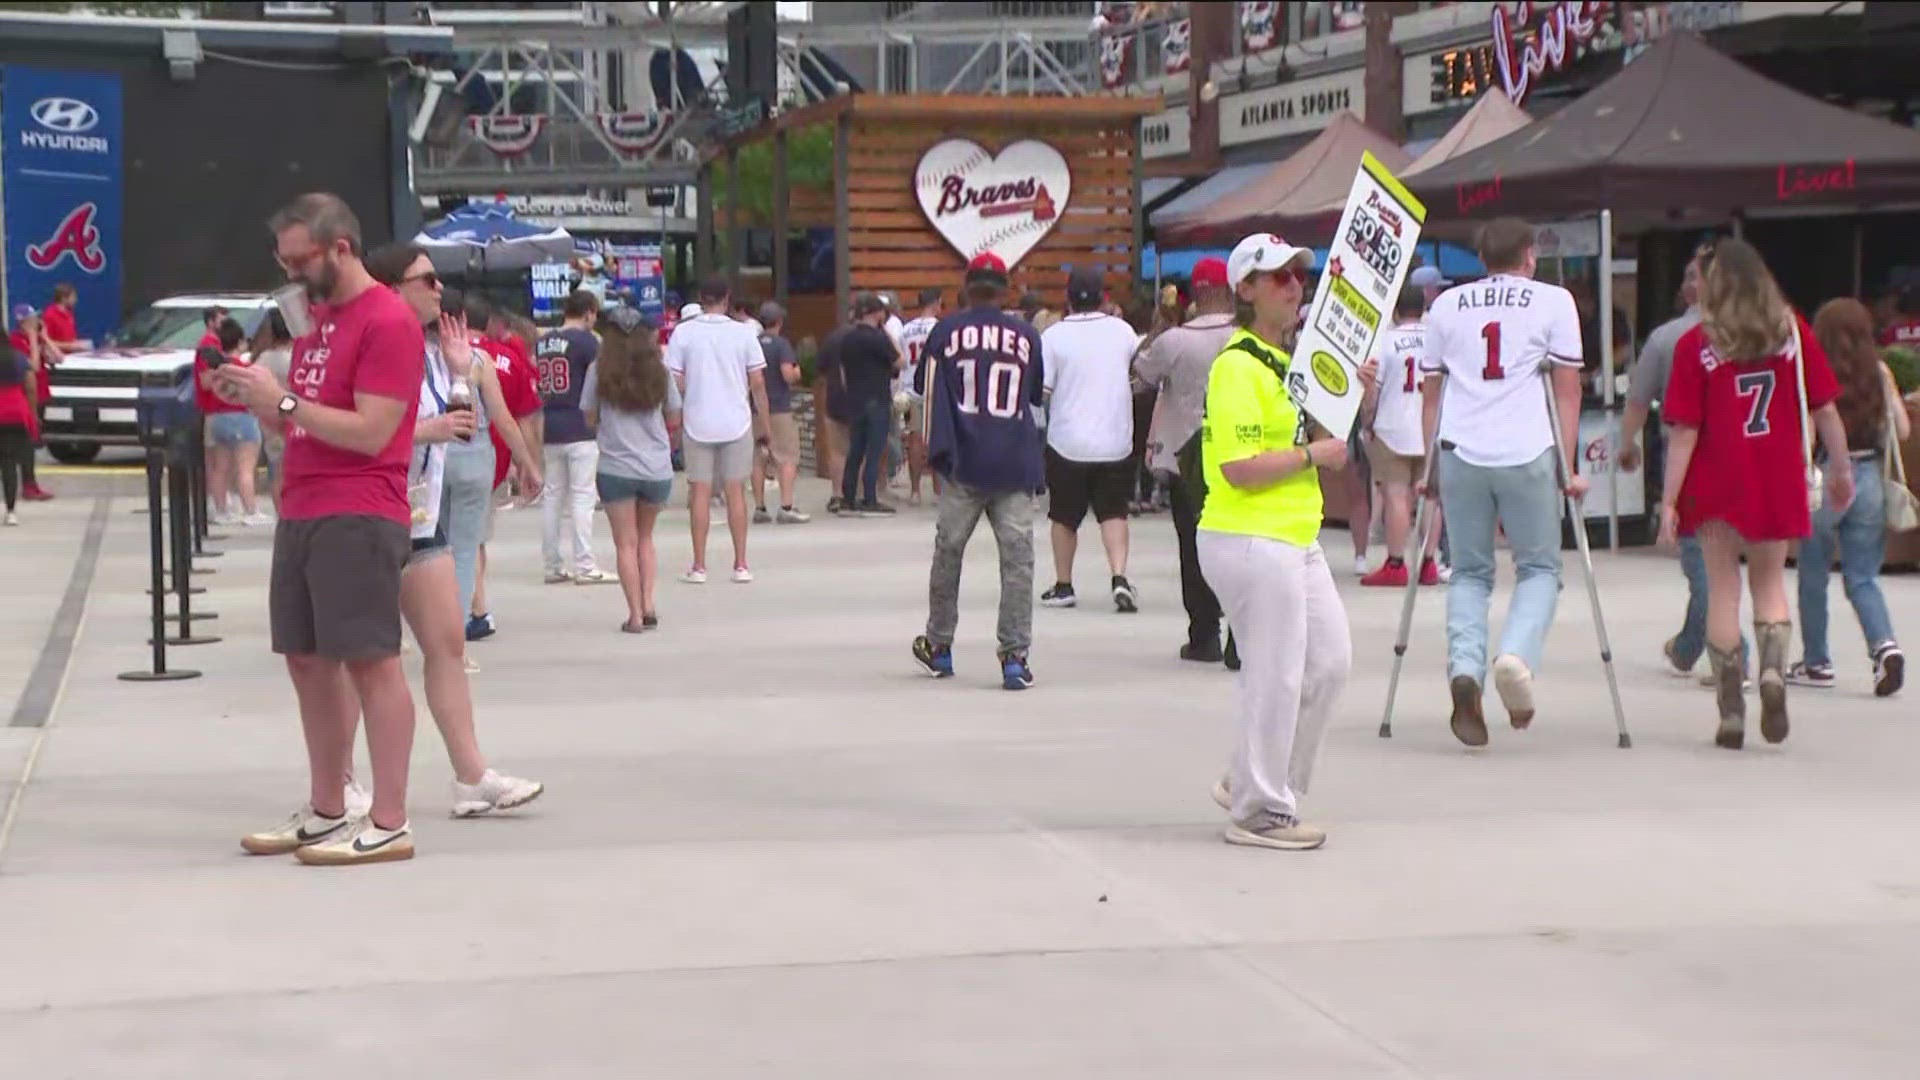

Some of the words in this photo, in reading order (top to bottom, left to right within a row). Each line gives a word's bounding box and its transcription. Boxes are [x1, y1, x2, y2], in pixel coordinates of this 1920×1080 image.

[1241, 99, 1294, 127] ATLANTA
[1301, 88, 1351, 115] SPORTS
[21, 131, 109, 153] HYUNDAI
[936, 175, 1036, 218] Braves
[1776, 158, 1857, 199] Live!
[515, 197, 577, 215] Georgia
[581, 197, 632, 214] Power
[1345, 227, 1396, 284] RAFFLE
[532, 281, 571, 298] WALK
[1457, 287, 1533, 312] ALBIES
[944, 325, 1031, 365] JONES
[1481, 321, 1505, 380] 1
[538, 357, 570, 393] 28
[1735, 370, 1776, 438] 7
